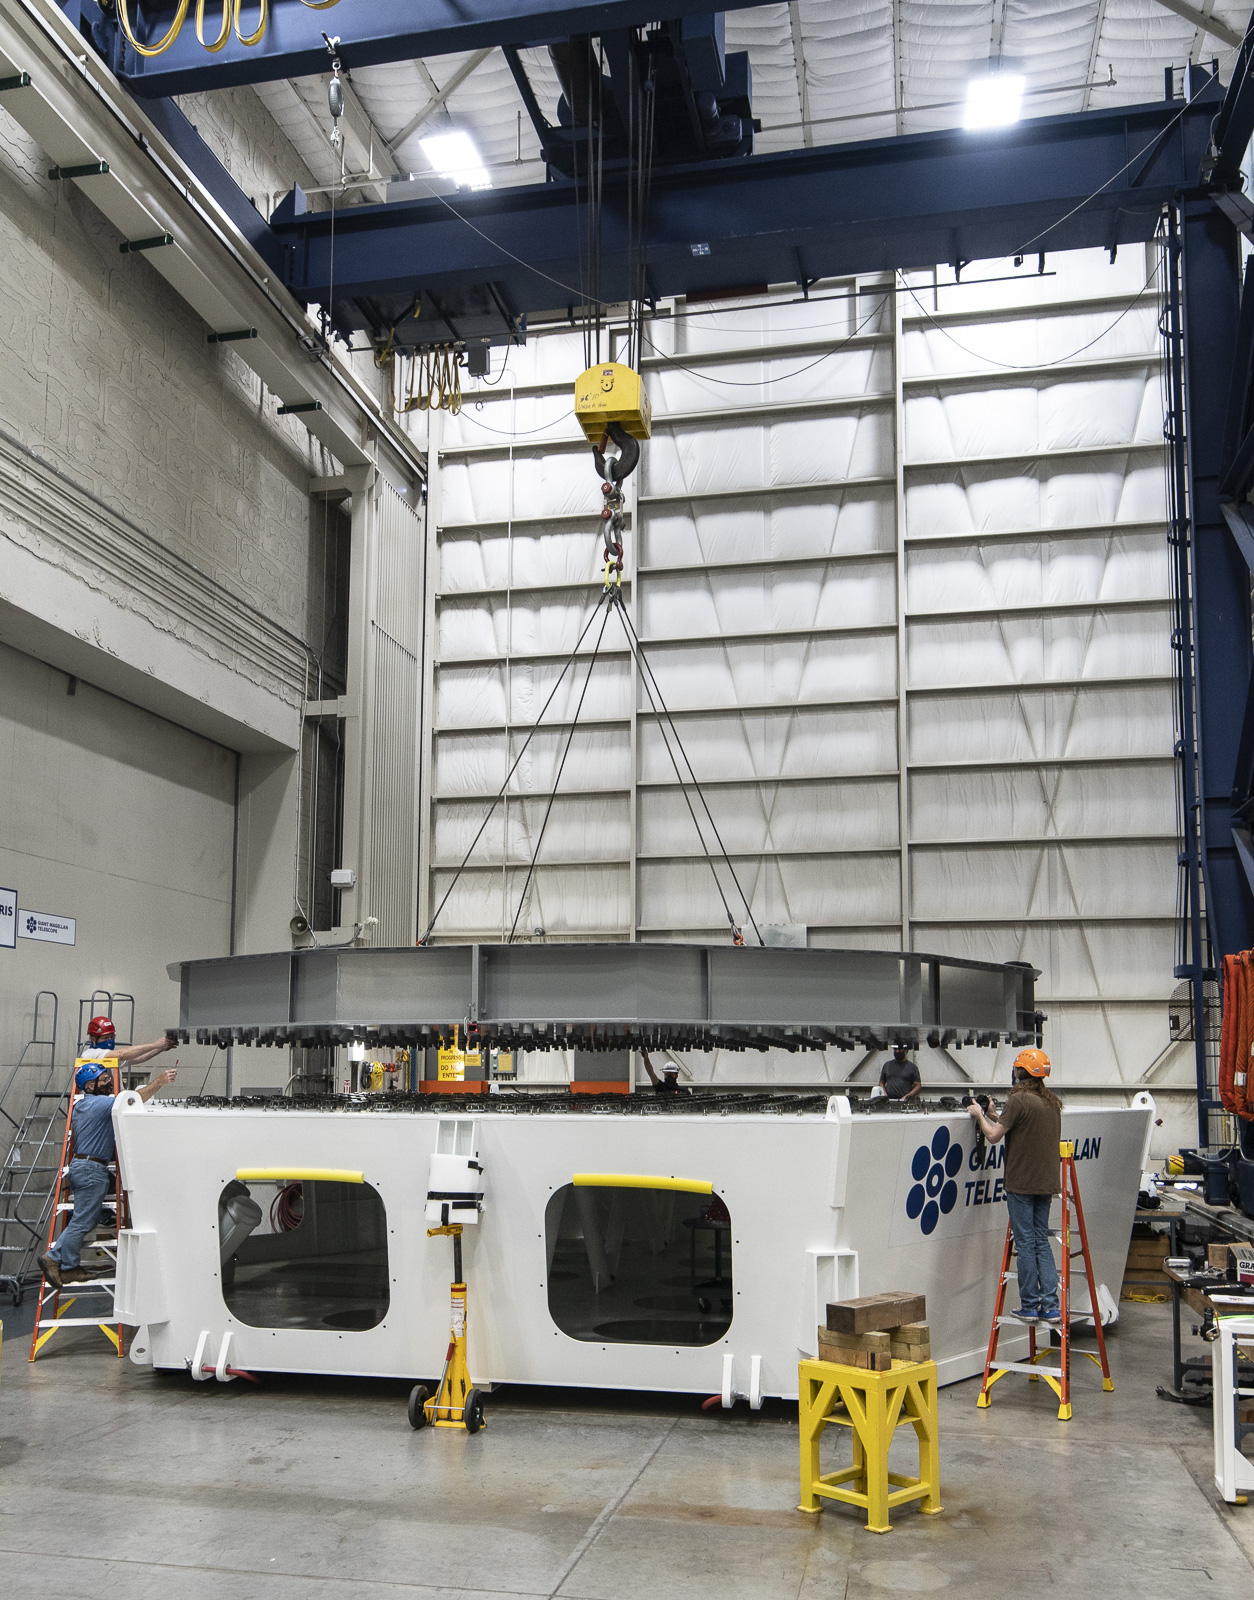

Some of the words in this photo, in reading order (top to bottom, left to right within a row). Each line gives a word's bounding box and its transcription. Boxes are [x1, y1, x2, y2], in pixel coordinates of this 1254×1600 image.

[38, 926, 57, 934] TELESCOPE
[50, 922, 68, 931] MAGELLAN
[969, 1145, 1005, 1172] GIAN
